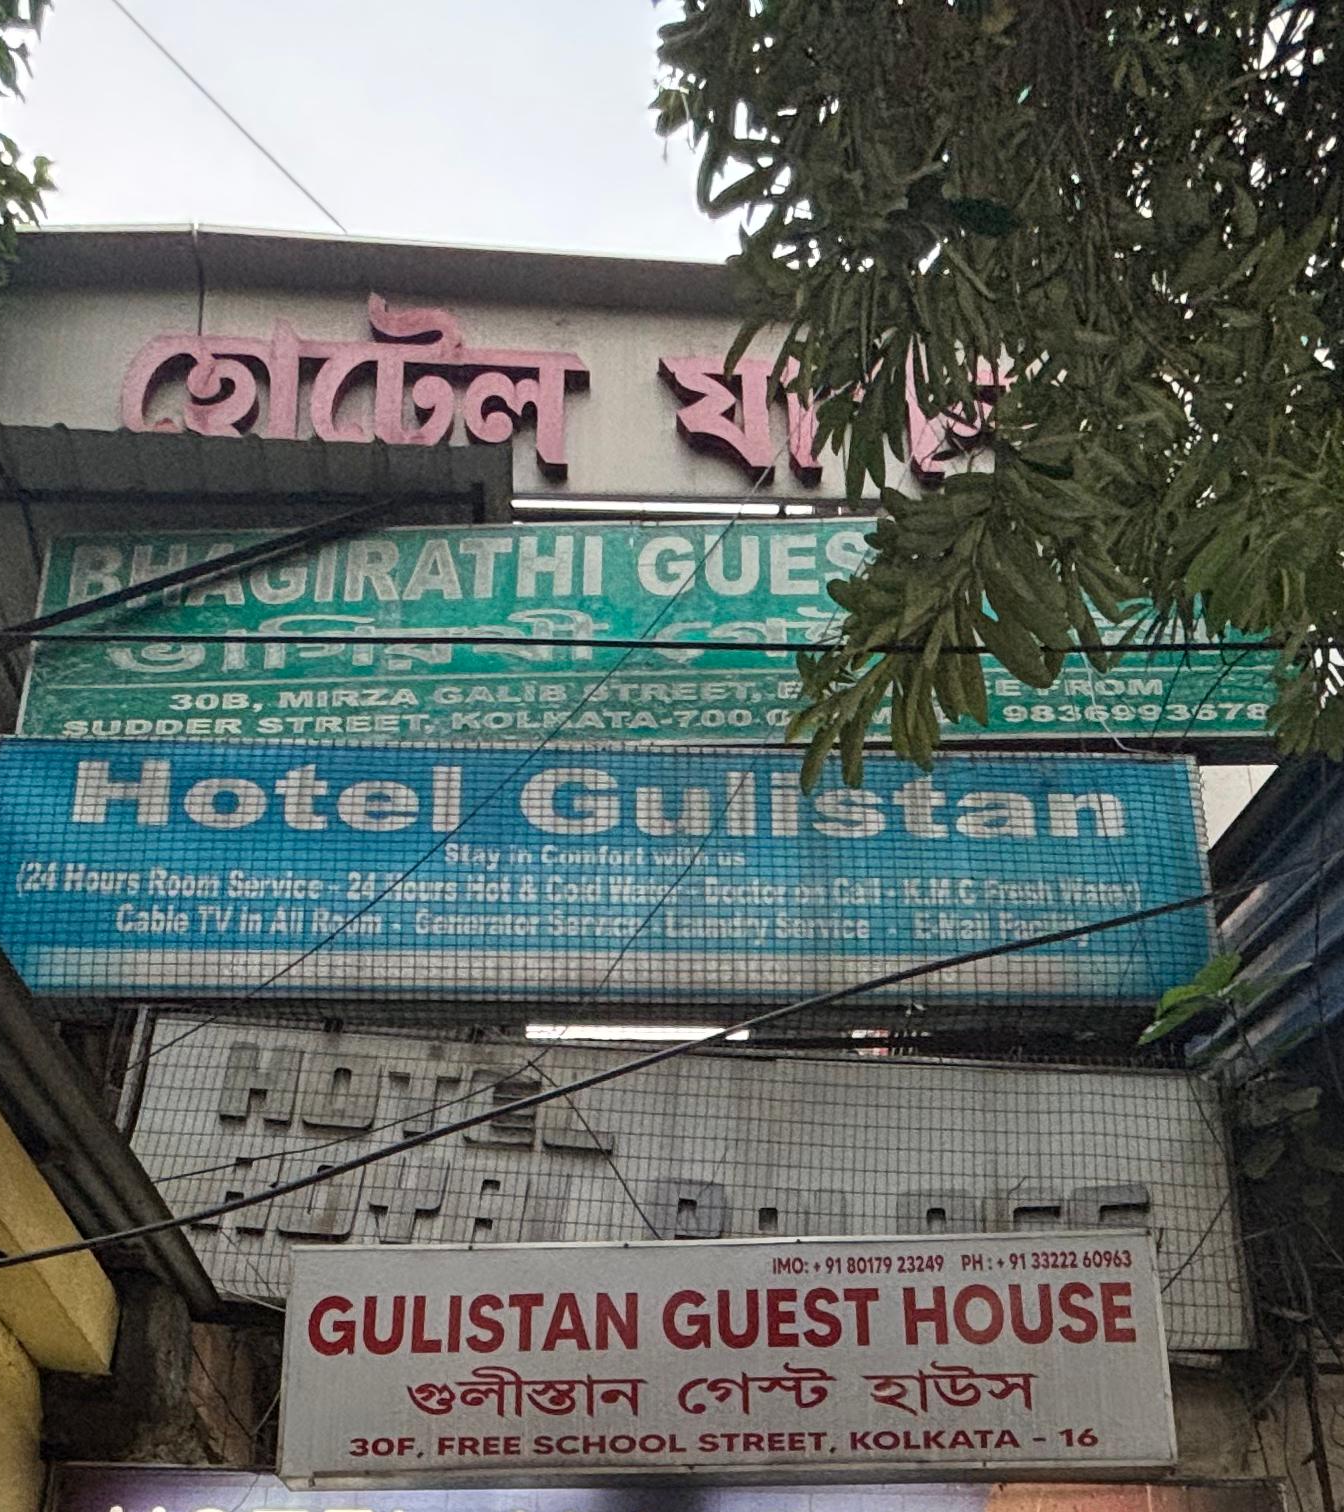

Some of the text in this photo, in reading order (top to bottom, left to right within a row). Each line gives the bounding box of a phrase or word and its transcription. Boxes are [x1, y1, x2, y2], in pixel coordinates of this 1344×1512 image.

[121, 293, 589, 470] হোটেল
[67, 531, 880, 608] BHAGIRATHI GUES
[169, 692, 263, 712] 30B,
[278, 687, 419, 708] MIRZA
[434, 684, 567, 705] GALIB
[586, 682, 761, 704] STREET,
[61, 717, 242, 738] SUDDER
[256, 714, 433, 735] STREET,
[71, 759, 1126, 839] Hotel Gulistan
[443, 843, 501, 871] Stay
[541, 844, 645, 866] Comfort
[654, 846, 707, 866] with
[717, 850, 746, 867] us
[63, 863, 141, 895] Hours
[148, 867, 220, 897] Room
[227, 869, 324, 900] Service
[347, 871, 376, 901] 24
[386, 872, 457, 901] Hours
[467, 874, 512, 902] Hot
[115, 903, 189, 933] Cable
[197, 906, 234, 934] TV
[239, 906, 263, 933] in
[269, 906, 305, 935] All
[311, 908, 382, 935] Room
[775, 912, 870, 940] Service
[219, 1040, 615, 1153] HOTEL
[846, 1256, 892, 1275] 80179
[897, 1254, 944, 1273] 23249
[1031, 1251, 1078, 1270] 33222
[1082, 1250, 1133, 1269] 60963
[308, 1282, 1137, 1356] GULISTAN GUEST HOUSE
[862, 1360, 1039, 1416] হাউস
[349, 1436, 425, 1459] 30F,
[437, 1436, 522, 1457] FREE
[533, 1433, 687, 1457] SCHOOL
[698, 1431, 837, 1455] STREET,
[850, 1428, 1021, 1451] KOLKATA
[1059, 1428, 1100, 1448] 16
